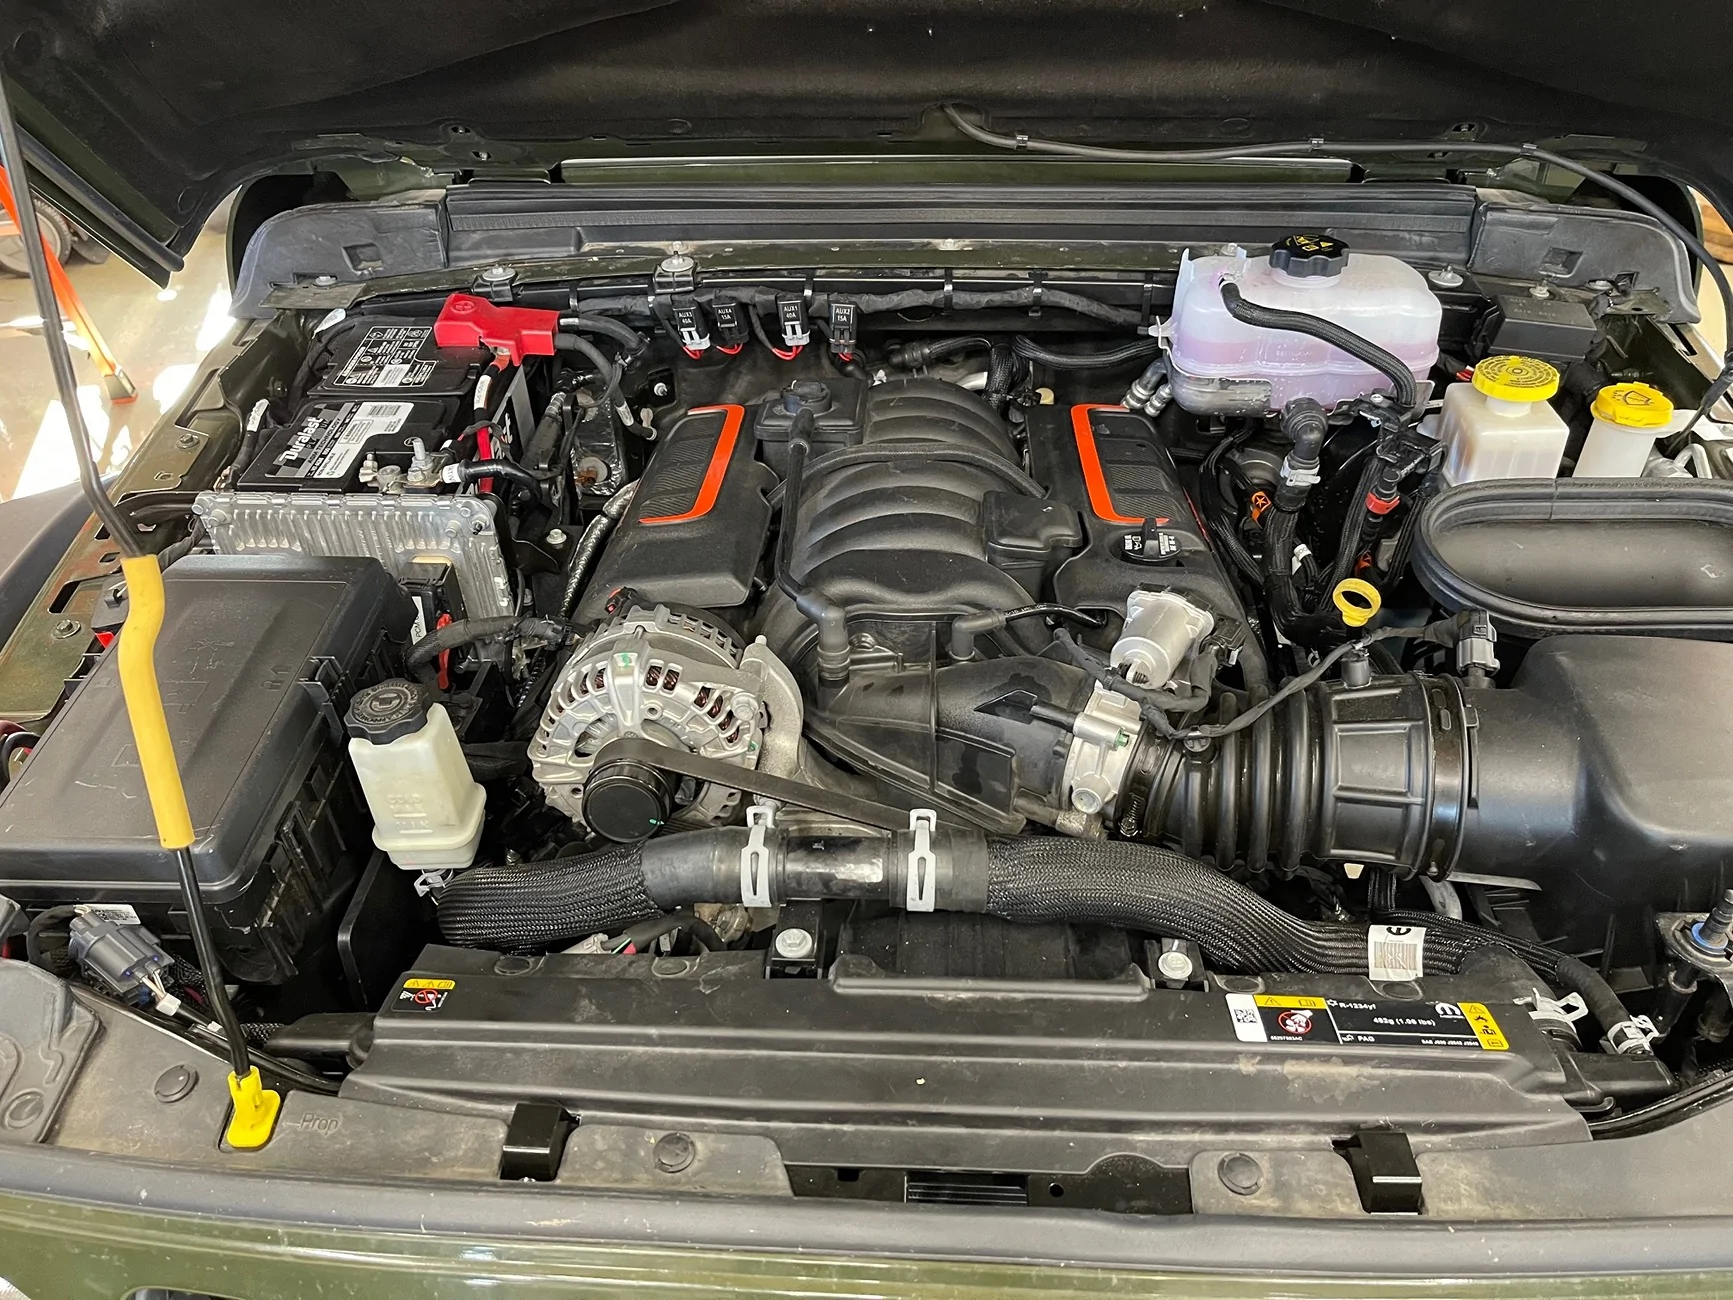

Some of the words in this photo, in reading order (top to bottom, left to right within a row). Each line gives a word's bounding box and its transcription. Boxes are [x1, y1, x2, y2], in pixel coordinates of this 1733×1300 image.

[279, 415, 324, 462] Duralast
[315, 418, 341, 451] TECHNOLOGY
[300, 1112, 340, 1137] Prop
